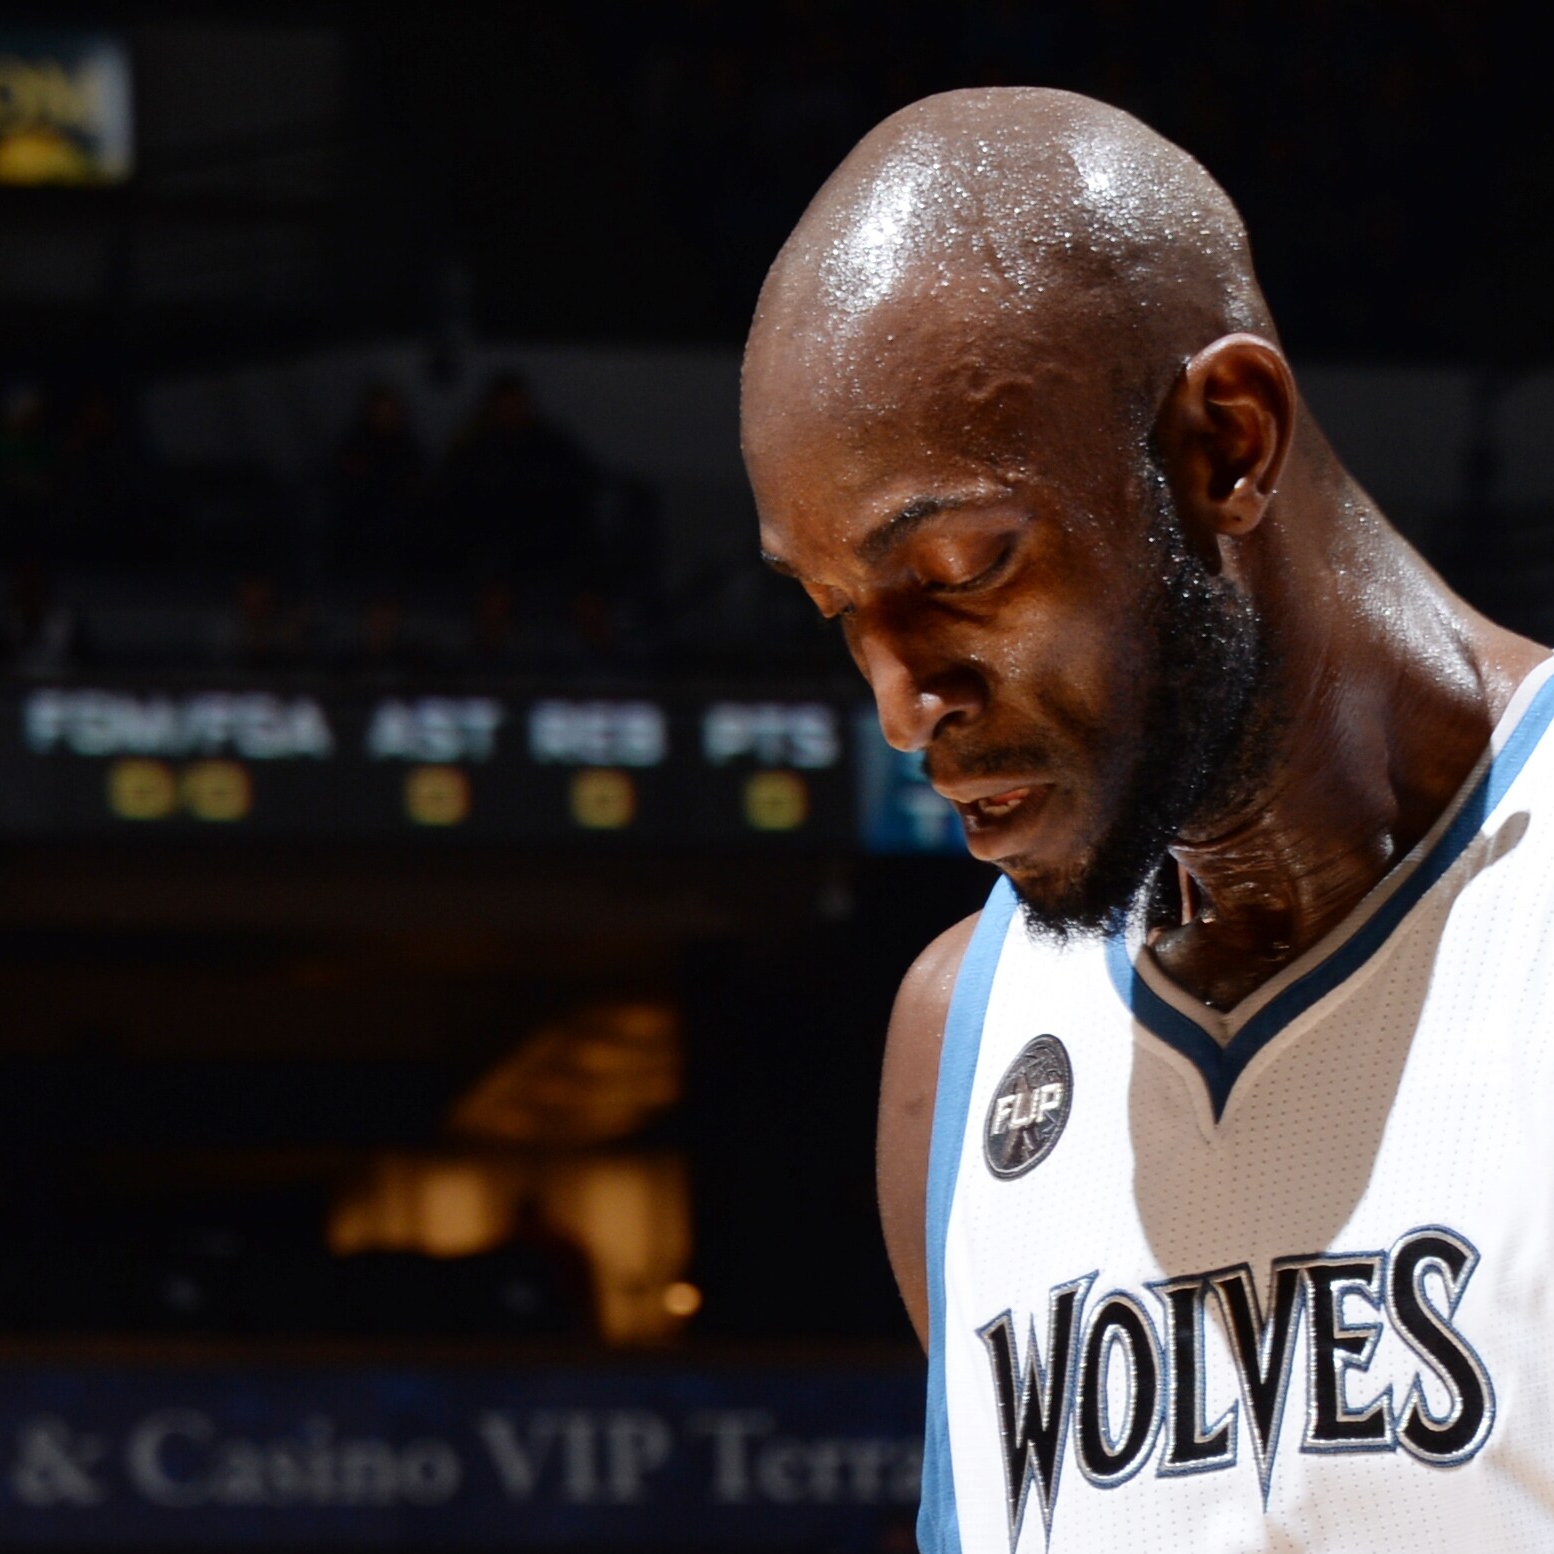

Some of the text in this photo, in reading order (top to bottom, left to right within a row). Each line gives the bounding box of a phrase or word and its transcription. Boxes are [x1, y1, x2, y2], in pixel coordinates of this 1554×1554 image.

[366, 698, 502, 764] AST
[528, 700, 666, 767] REB
[702, 702, 840, 769] PTS
[991, 1082, 1064, 1136] FLIP
[124, 1408, 462, 1508] Casino
[474, 1408, 674, 1506] VIP
